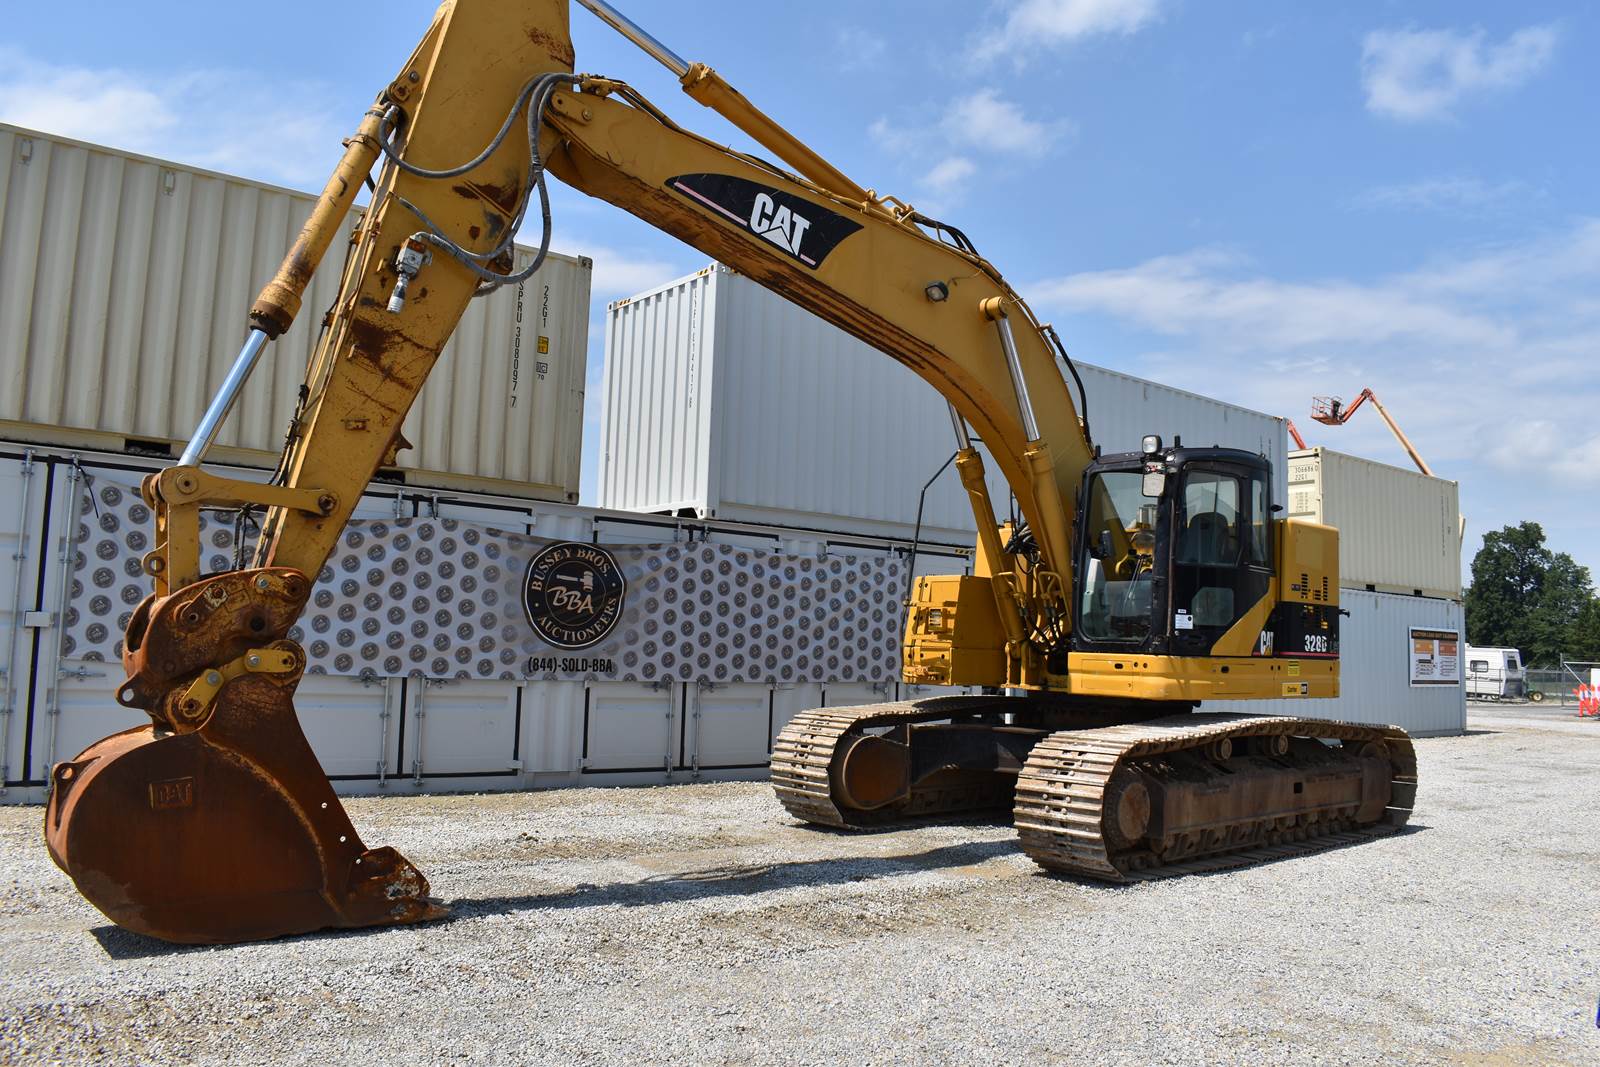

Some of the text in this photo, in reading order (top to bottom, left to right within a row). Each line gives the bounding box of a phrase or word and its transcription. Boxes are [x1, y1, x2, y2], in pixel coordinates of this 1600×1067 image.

[750, 192, 812, 256] CAT
[512, 326, 521, 391] 308097
[511, 396, 517, 407] 7
[531, 548, 611, 592] BUSSEY BROS.
[547, 586, 594, 614] BBA
[537, 597, 617, 642] AUCTIONEERS
[1260, 630, 1274, 656] CAT
[528, 657, 612, 673] (844)-SOLD-BBA
